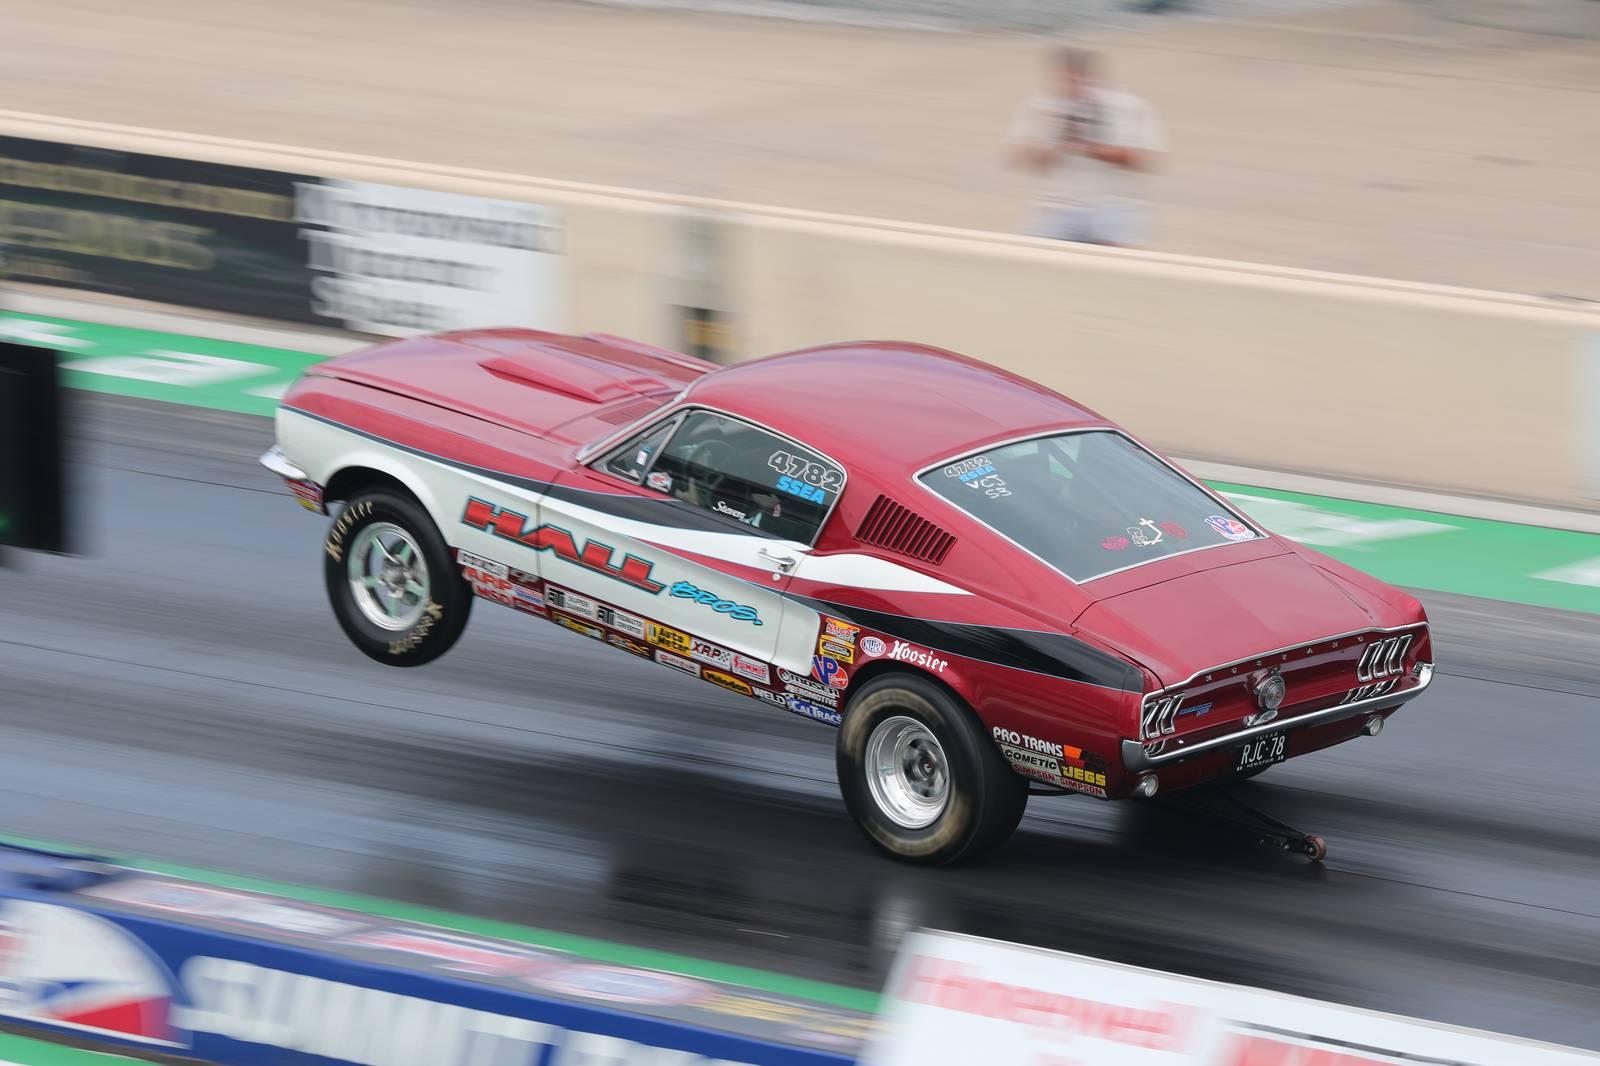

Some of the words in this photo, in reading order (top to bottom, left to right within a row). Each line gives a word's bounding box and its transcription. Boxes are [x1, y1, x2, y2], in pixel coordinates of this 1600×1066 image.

[768, 450, 844, 494] 4782
[944, 455, 992, 478] 4782
[776, 475, 826, 505] SSEA
[461, 495, 668, 595] HALL
[691, 641, 722, 659] XRP
[887, 640, 948, 672] Hoosier
[813, 655, 839, 686] VP
[992, 726, 1021, 745] PRO
[1022, 734, 1064, 757] TRANS
[1004, 749, 1058, 770] COMETIC
[1013, 763, 1057, 782] SIMPSON
[1060, 777, 1103, 795] SIMPSON
[1061, 765, 1106, 786] JEGS
